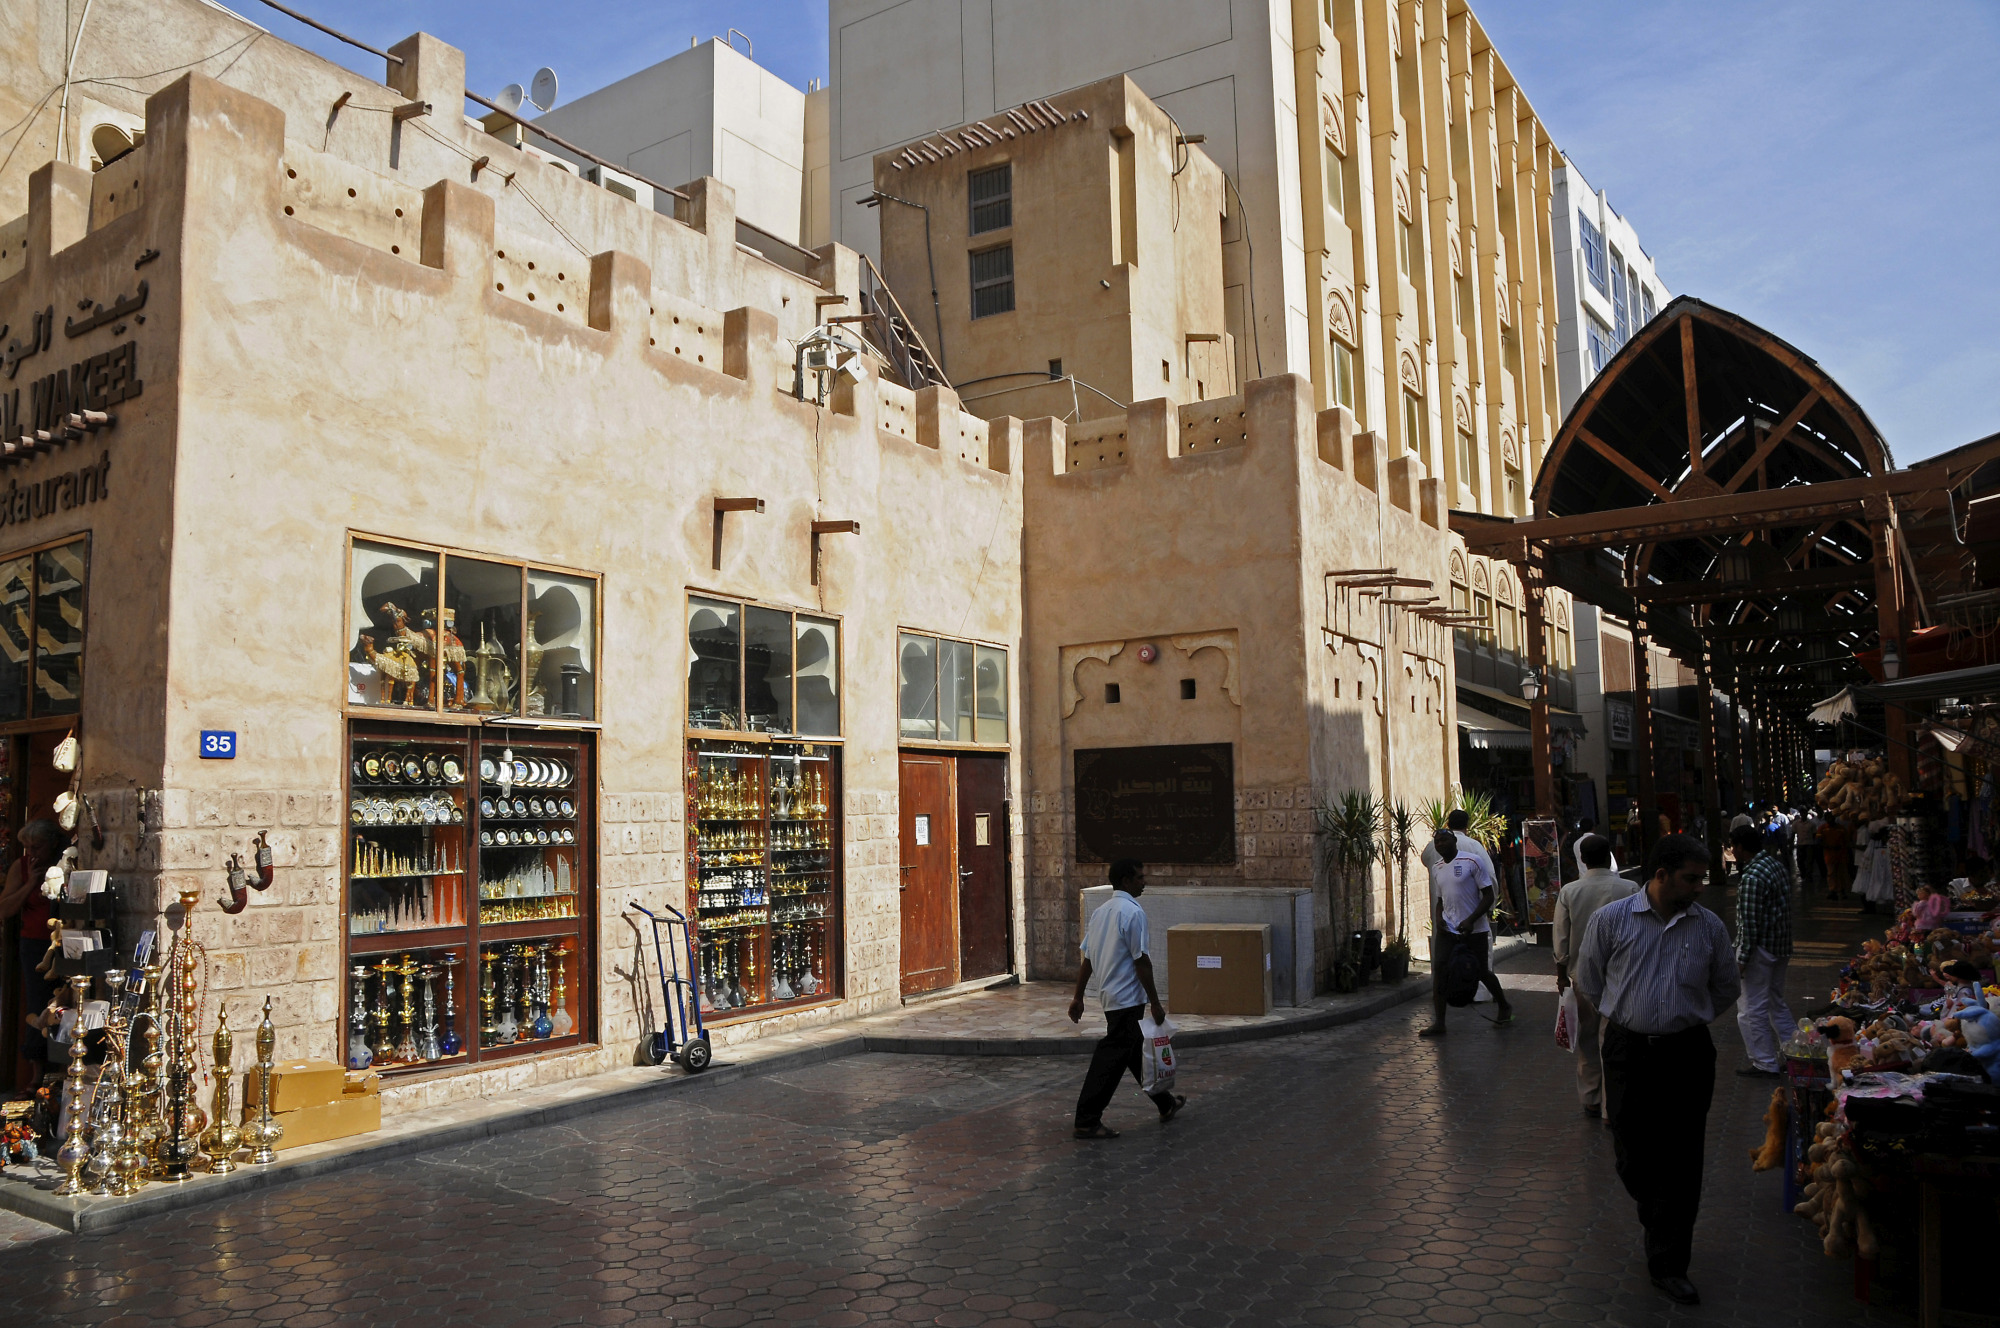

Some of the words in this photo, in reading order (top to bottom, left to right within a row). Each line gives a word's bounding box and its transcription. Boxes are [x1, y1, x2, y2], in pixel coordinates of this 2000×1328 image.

[64, 279, 149, 338] بيت
[30, 340, 143, 434] WAKEEL
[205, 735, 231, 752] 35
[1112, 777, 1177, 798] الوكيل
